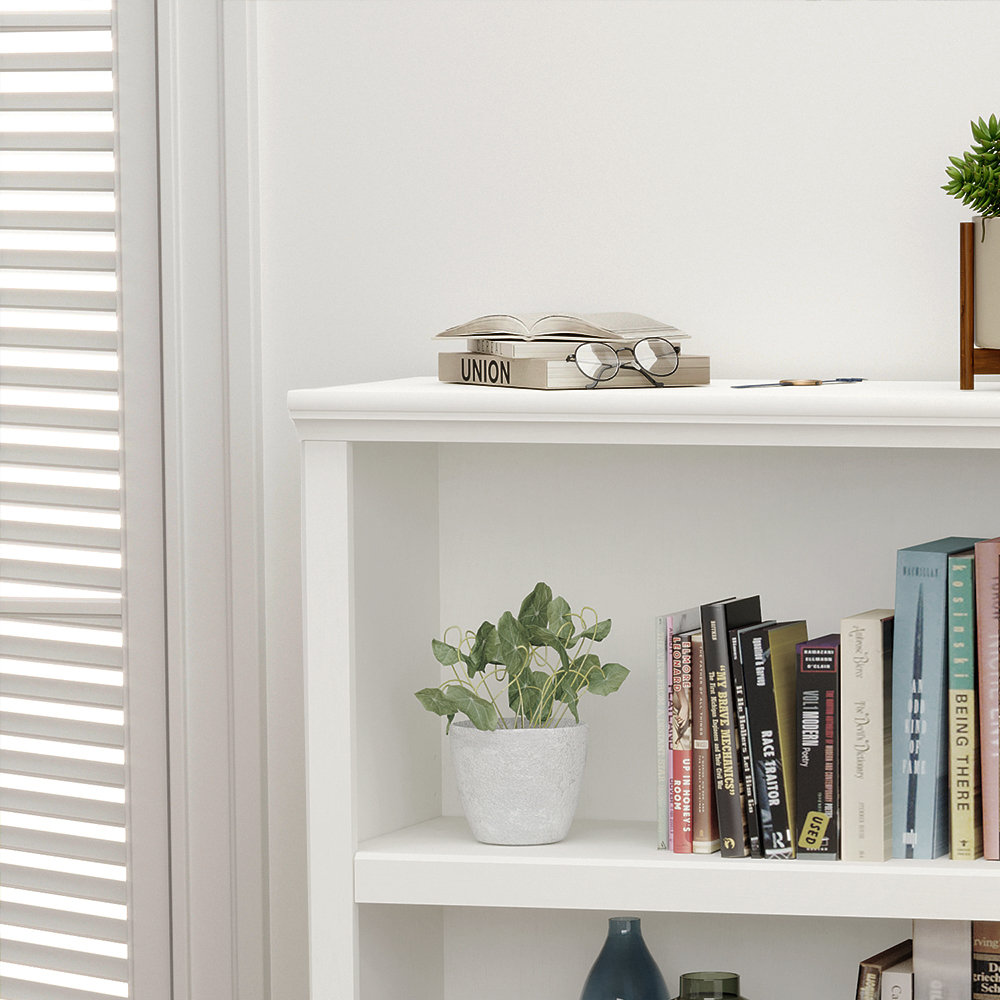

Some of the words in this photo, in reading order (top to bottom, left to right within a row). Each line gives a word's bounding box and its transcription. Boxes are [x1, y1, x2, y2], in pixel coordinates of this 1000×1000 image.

[461, 358, 510, 384] UNION
[952, 565, 969, 678] kosinski
[673, 637, 682, 692] LEONARD
[682, 641, 691, 689] ELMORE
[710, 697, 718, 717] Michigan
[718, 692, 729, 726] BRAVE
[802, 690, 819, 704] VOL
[802, 711, 819, 746] MODERN
[956, 695, 968, 747] BEING
[761, 730, 775, 758] RACE
[800, 747, 810, 767] Poetry
[682, 758, 690, 772] UP
[682, 775, 690, 786] IN
[765, 760, 780, 806] TRAITOR
[957, 755, 969, 811] THERE
[683, 789, 691, 832] HONEY'S
[806, 817, 823, 844] USED
